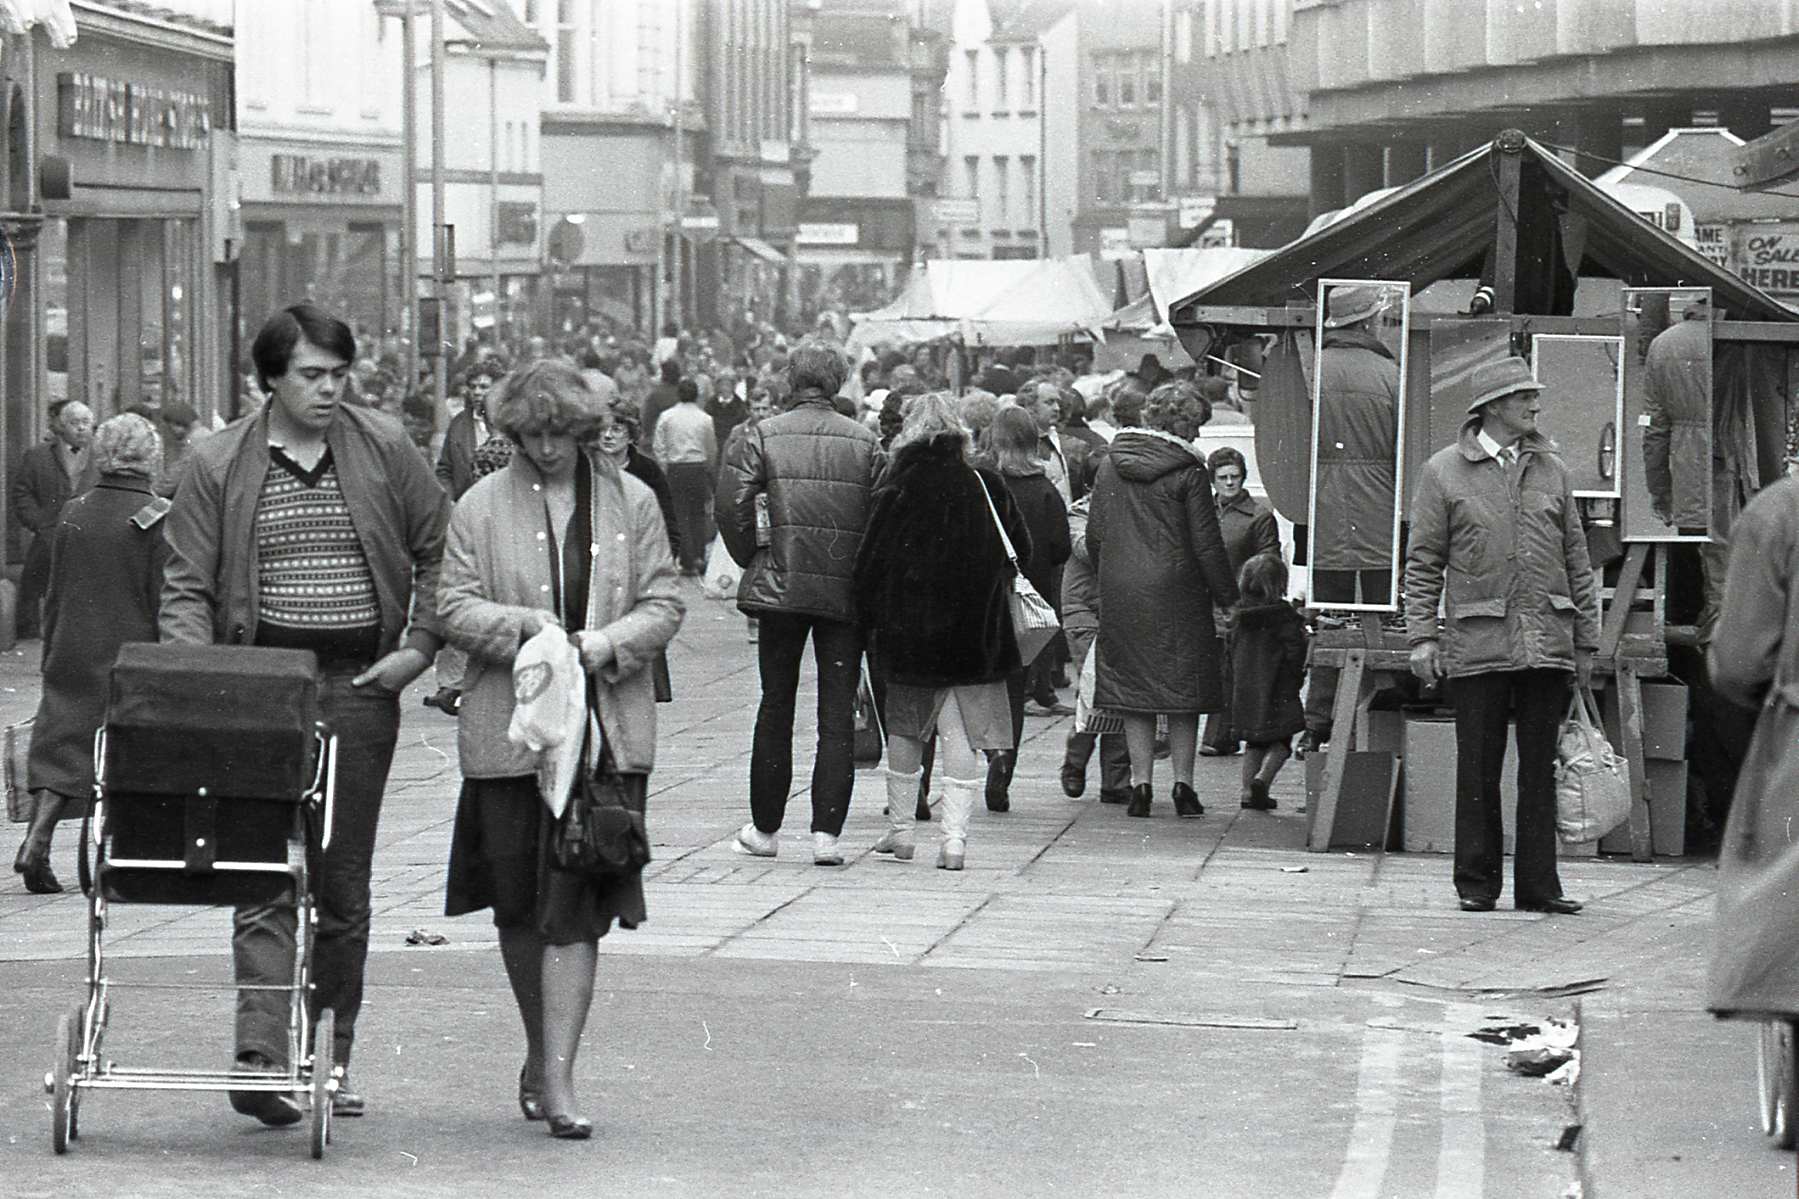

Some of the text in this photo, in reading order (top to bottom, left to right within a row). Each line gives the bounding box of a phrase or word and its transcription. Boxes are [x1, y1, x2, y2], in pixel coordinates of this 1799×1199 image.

[1749, 236, 1783, 251] ON
[1755, 249, 1799, 265] SALE
[1741, 267, 1799, 289] HERE
